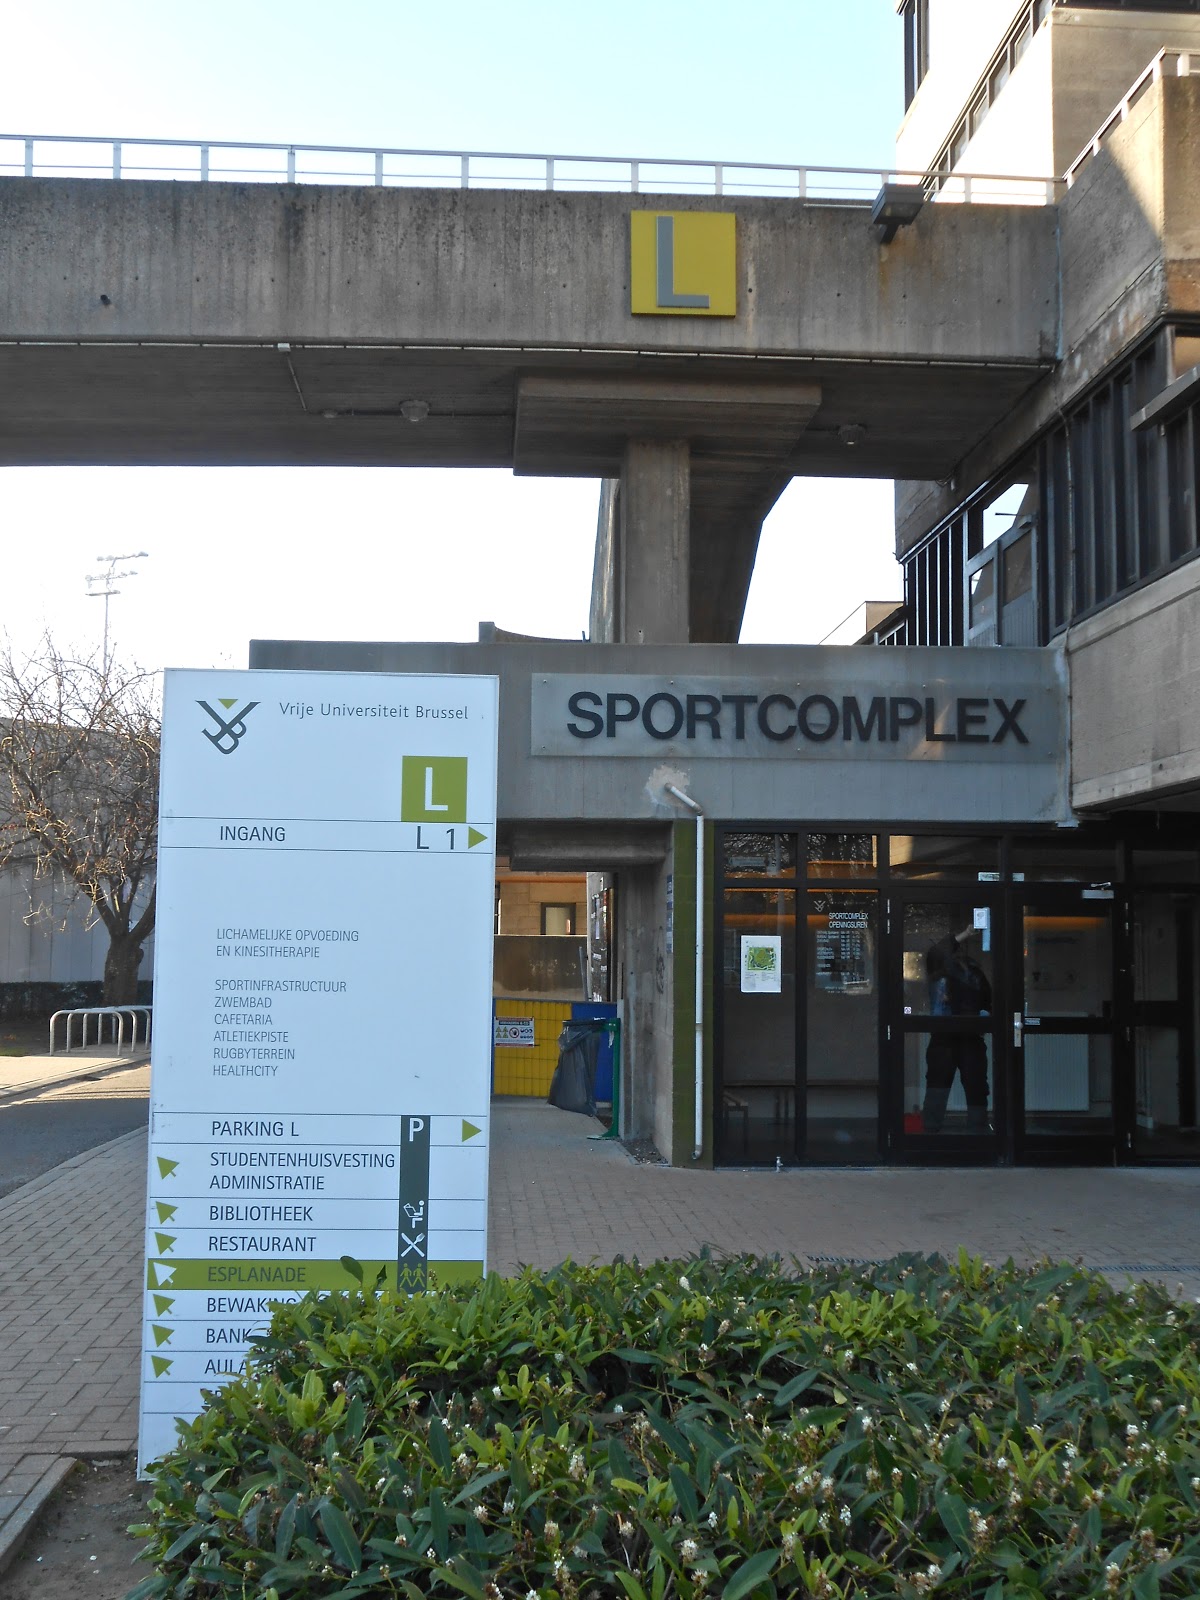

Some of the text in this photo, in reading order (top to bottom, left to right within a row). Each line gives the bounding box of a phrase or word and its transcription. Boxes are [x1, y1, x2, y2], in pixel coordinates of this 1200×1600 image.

[656, 215, 709, 308] L
[279, 702, 468, 719] Vrije Universiteit Brussel
[567, 692, 1029, 744] SPORTCOMPLEX
[425, 766, 449, 811] L
[219, 825, 286, 842] INGANG
[416, 825, 455, 850] L 1
[828, 912, 869, 920] SPORTCOMPLEX
[828, 921, 868, 929] OPENINGSUREN
[217, 928, 359, 942] LICHAMELIJKE OPVOEDING
[216, 945, 320, 958] EN KINESITHERAPIE
[215, 979, 347, 992] SPORTINFRASTRUCTUUR
[214, 996, 272, 1009] ZWEMBAD
[214, 1013, 273, 1026] CAFETARIA
[213, 1030, 289, 1043] ATLETIEKPISTE
[213, 1047, 295, 1060] RUGBYTERREIN
[213, 1064, 278, 1077] HEALTHCITY
[211, 1121, 299, 1137] PARKING L
[409, 1117, 424, 1142] P
[210, 1152, 395, 1168] STUDENTENHUISVESTING
[209, 1175, 325, 1190] ADMINISTRATIE
[209, 1206, 313, 1221] BIBLIOTHEEK
[208, 1236, 317, 1252] RESTAURANT
[207, 1267, 306, 1283] ESPLANADE
